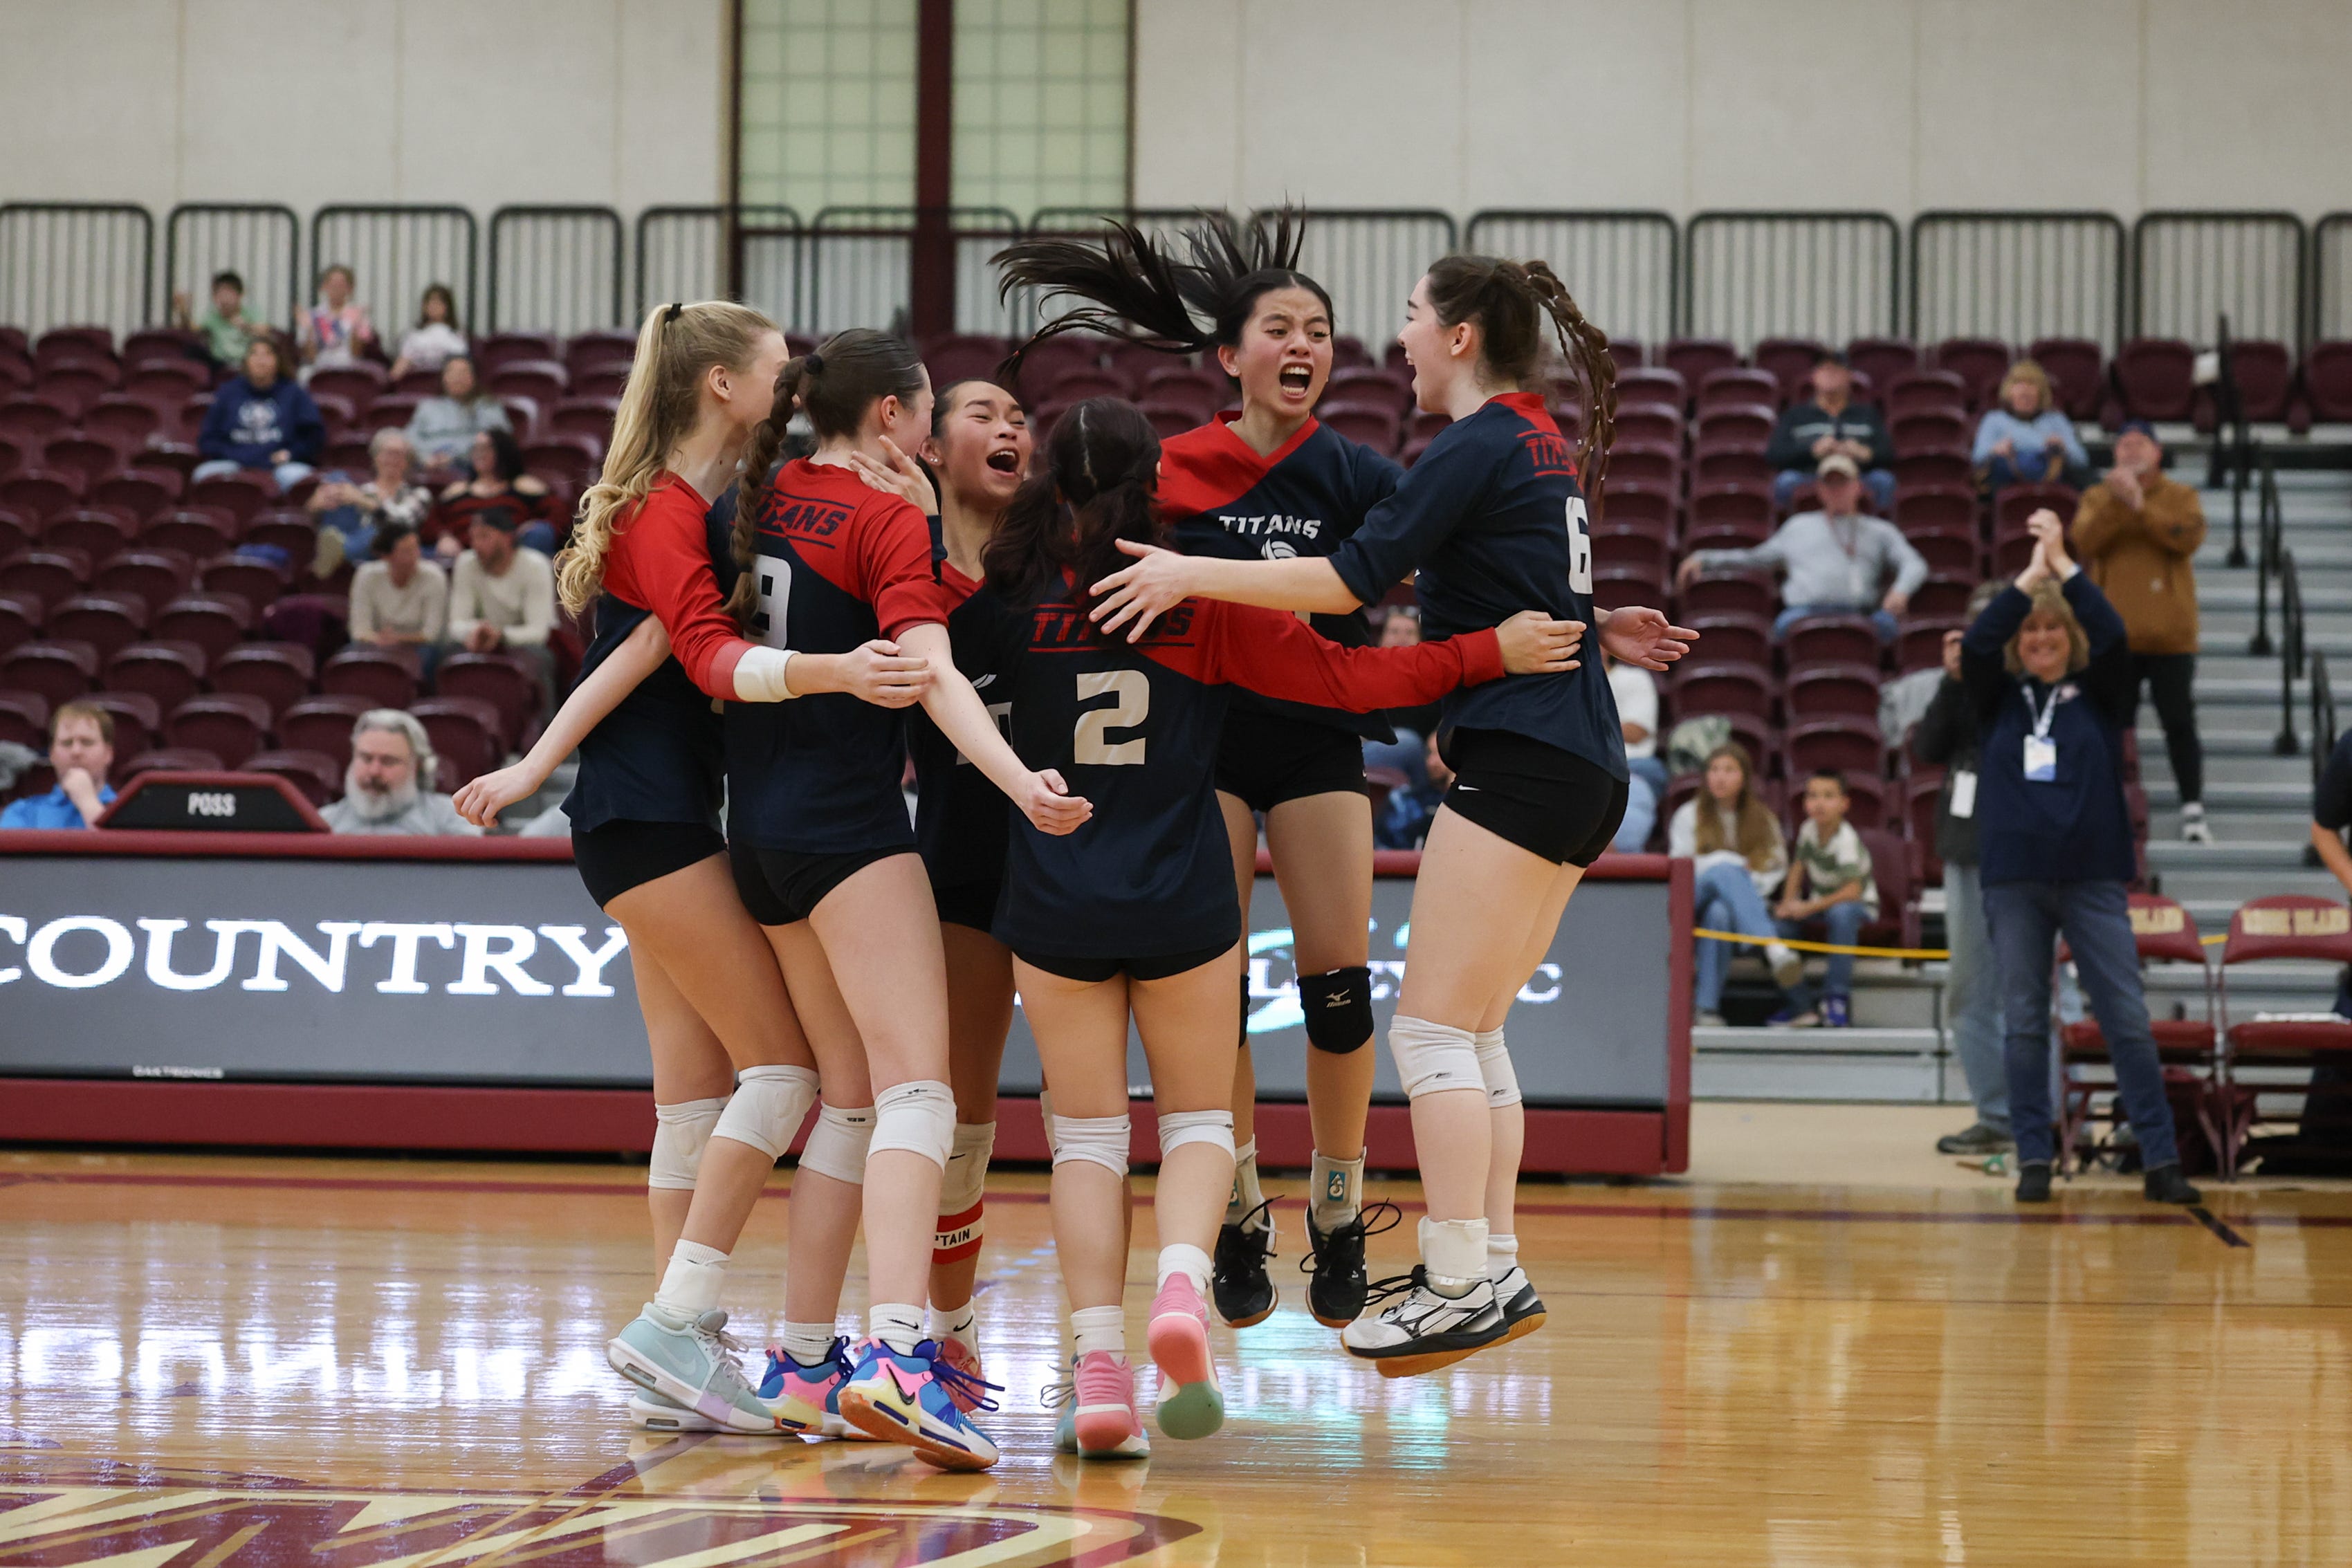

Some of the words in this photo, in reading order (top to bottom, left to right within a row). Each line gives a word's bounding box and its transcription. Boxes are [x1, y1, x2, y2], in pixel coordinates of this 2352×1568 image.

[1219, 514, 1321, 539] TITANS
[1565, 496, 1593, 595] 6
[1074, 670, 1150, 765] 2
[187, 792, 236, 817] POSS
[0, 914, 629, 997] OUNTRY
